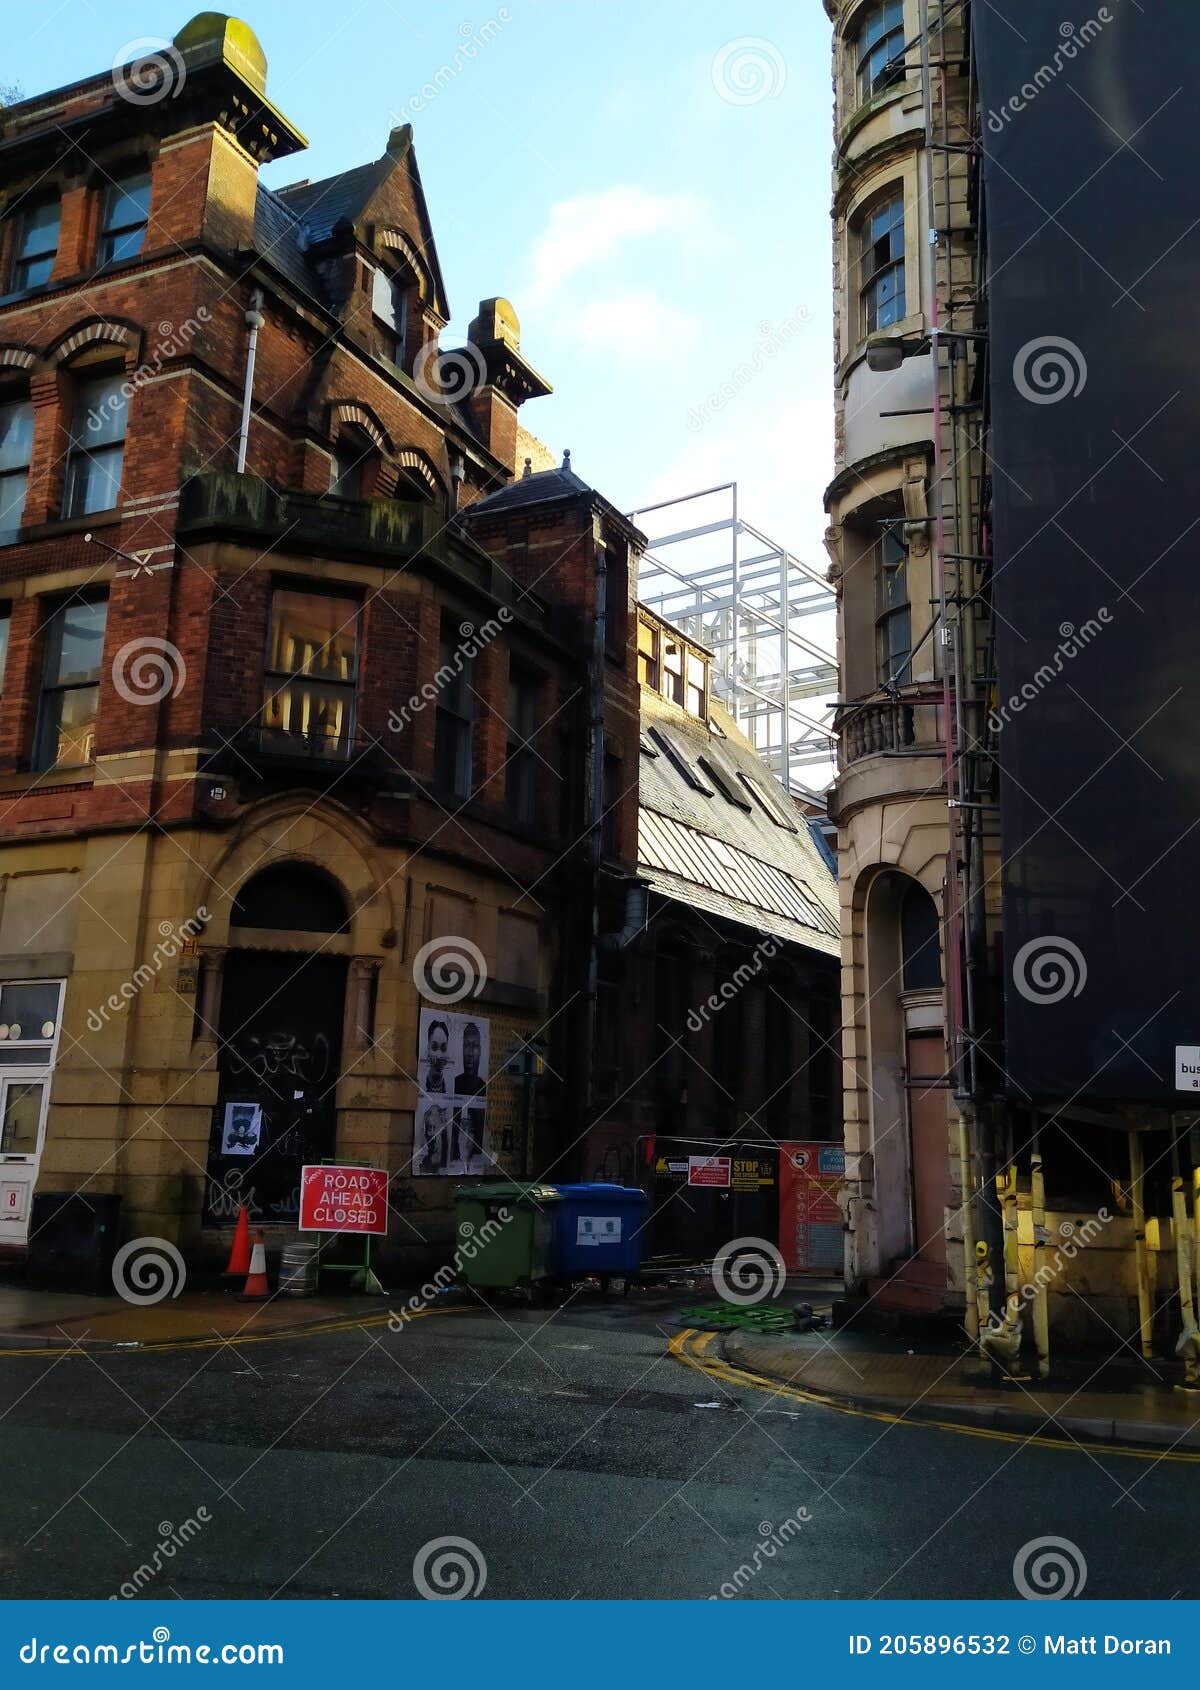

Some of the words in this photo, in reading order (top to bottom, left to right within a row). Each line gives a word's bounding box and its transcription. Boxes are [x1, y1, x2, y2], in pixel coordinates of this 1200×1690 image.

[733, 1160, 759, 1172] STOP
[795, 1153, 805, 1165] 5
[324, 1174, 370, 1190] ROAD
[9, 1192, 17, 1207] 8
[319, 1191, 374, 1207] AHEAD
[313, 1207, 377, 1224] CLOSED
